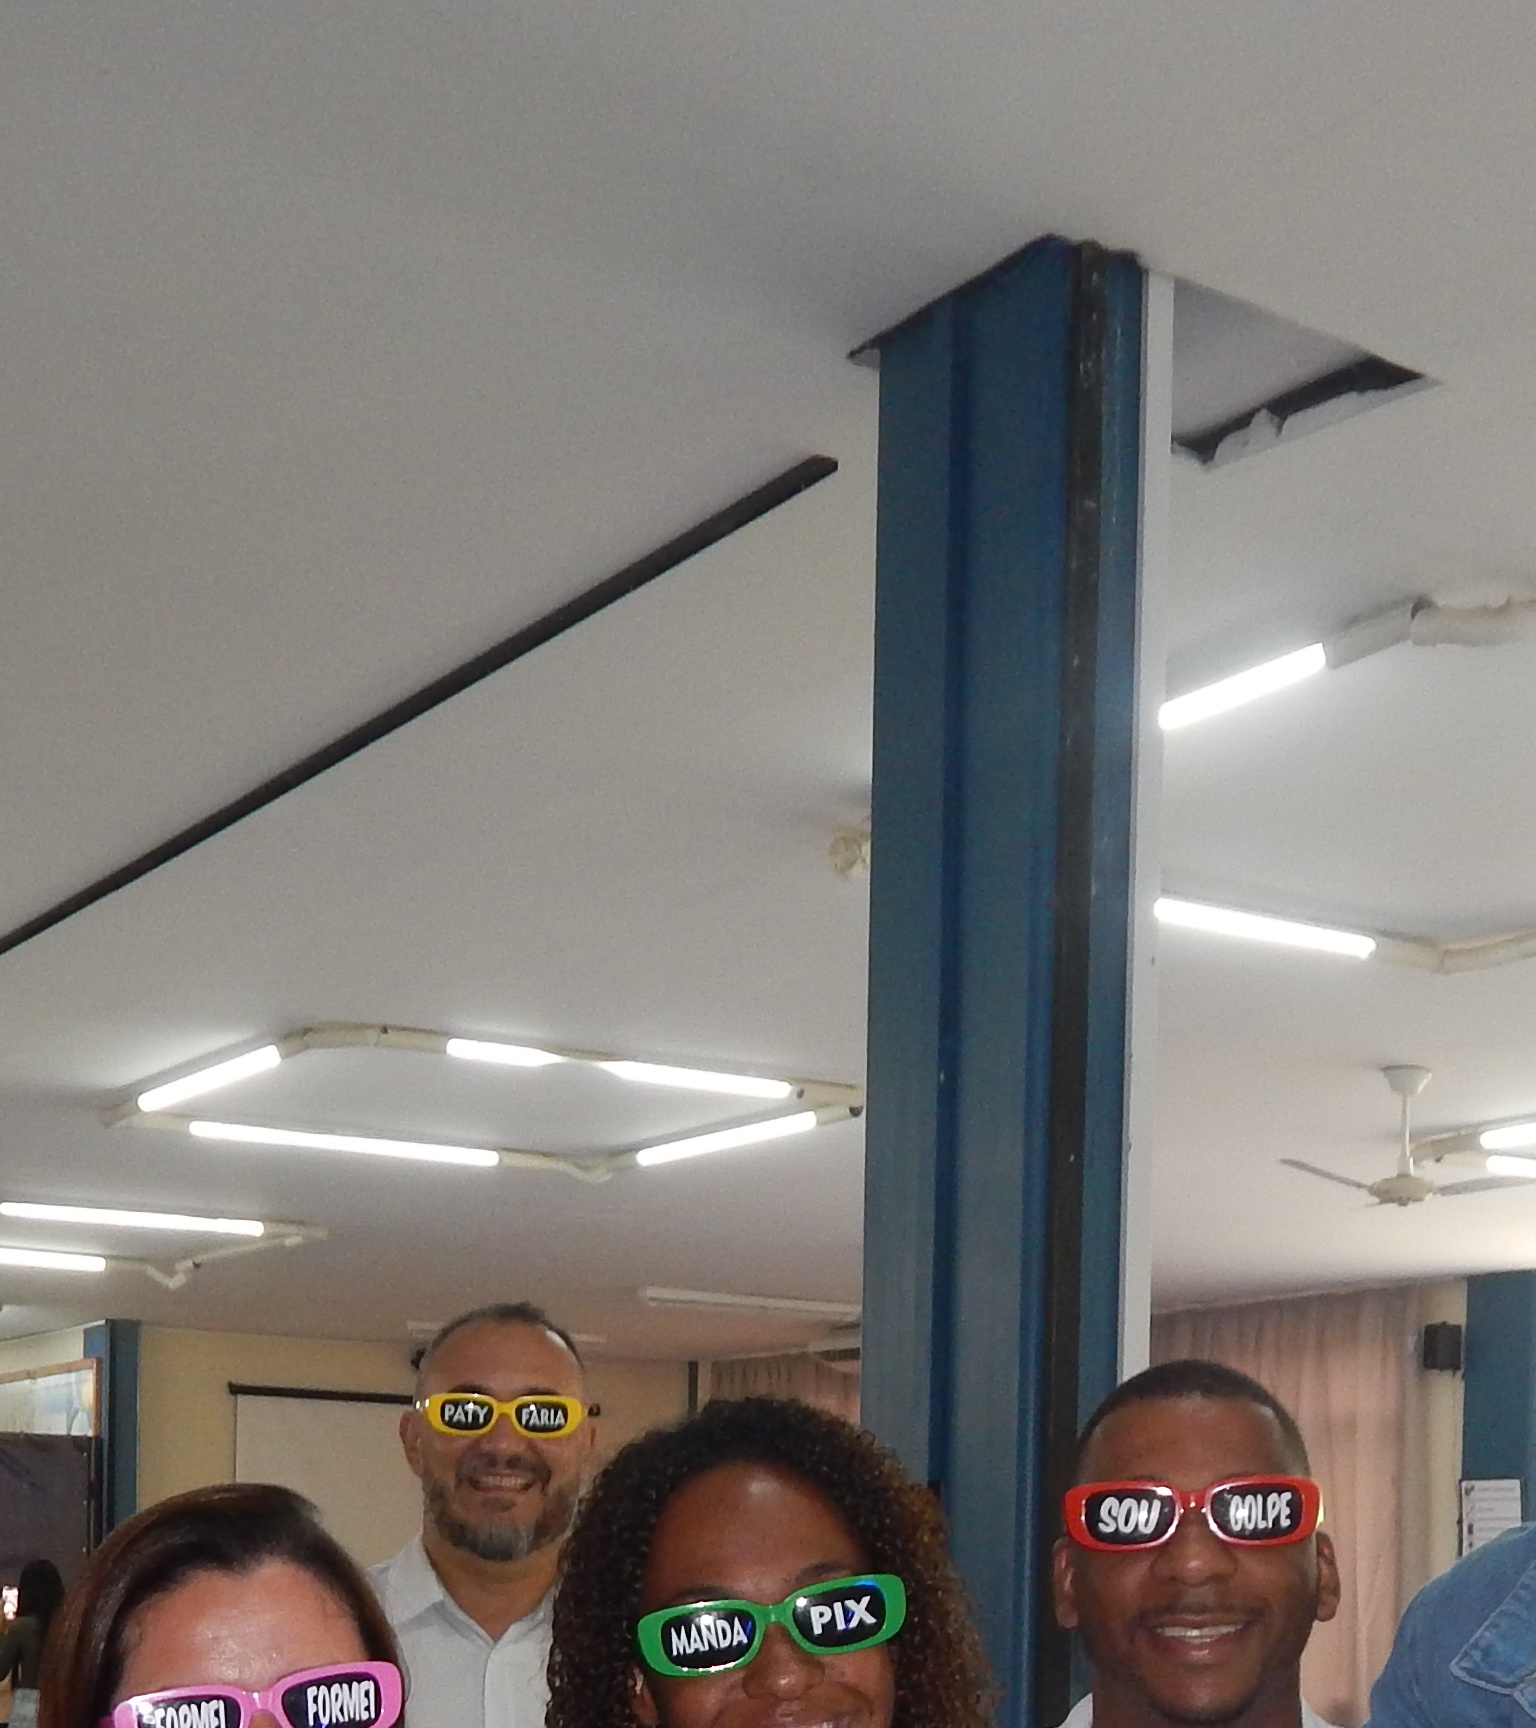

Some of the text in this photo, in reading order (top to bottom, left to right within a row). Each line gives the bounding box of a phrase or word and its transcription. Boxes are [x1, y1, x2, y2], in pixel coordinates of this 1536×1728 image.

[443, 1403, 565, 1426] PATY FARIA
[1097, 1491, 1293, 1534] SOU GOLPE
[670, 1596, 877, 1657] MANDA PIX
[307, 1680, 376, 1726] FORMEI
